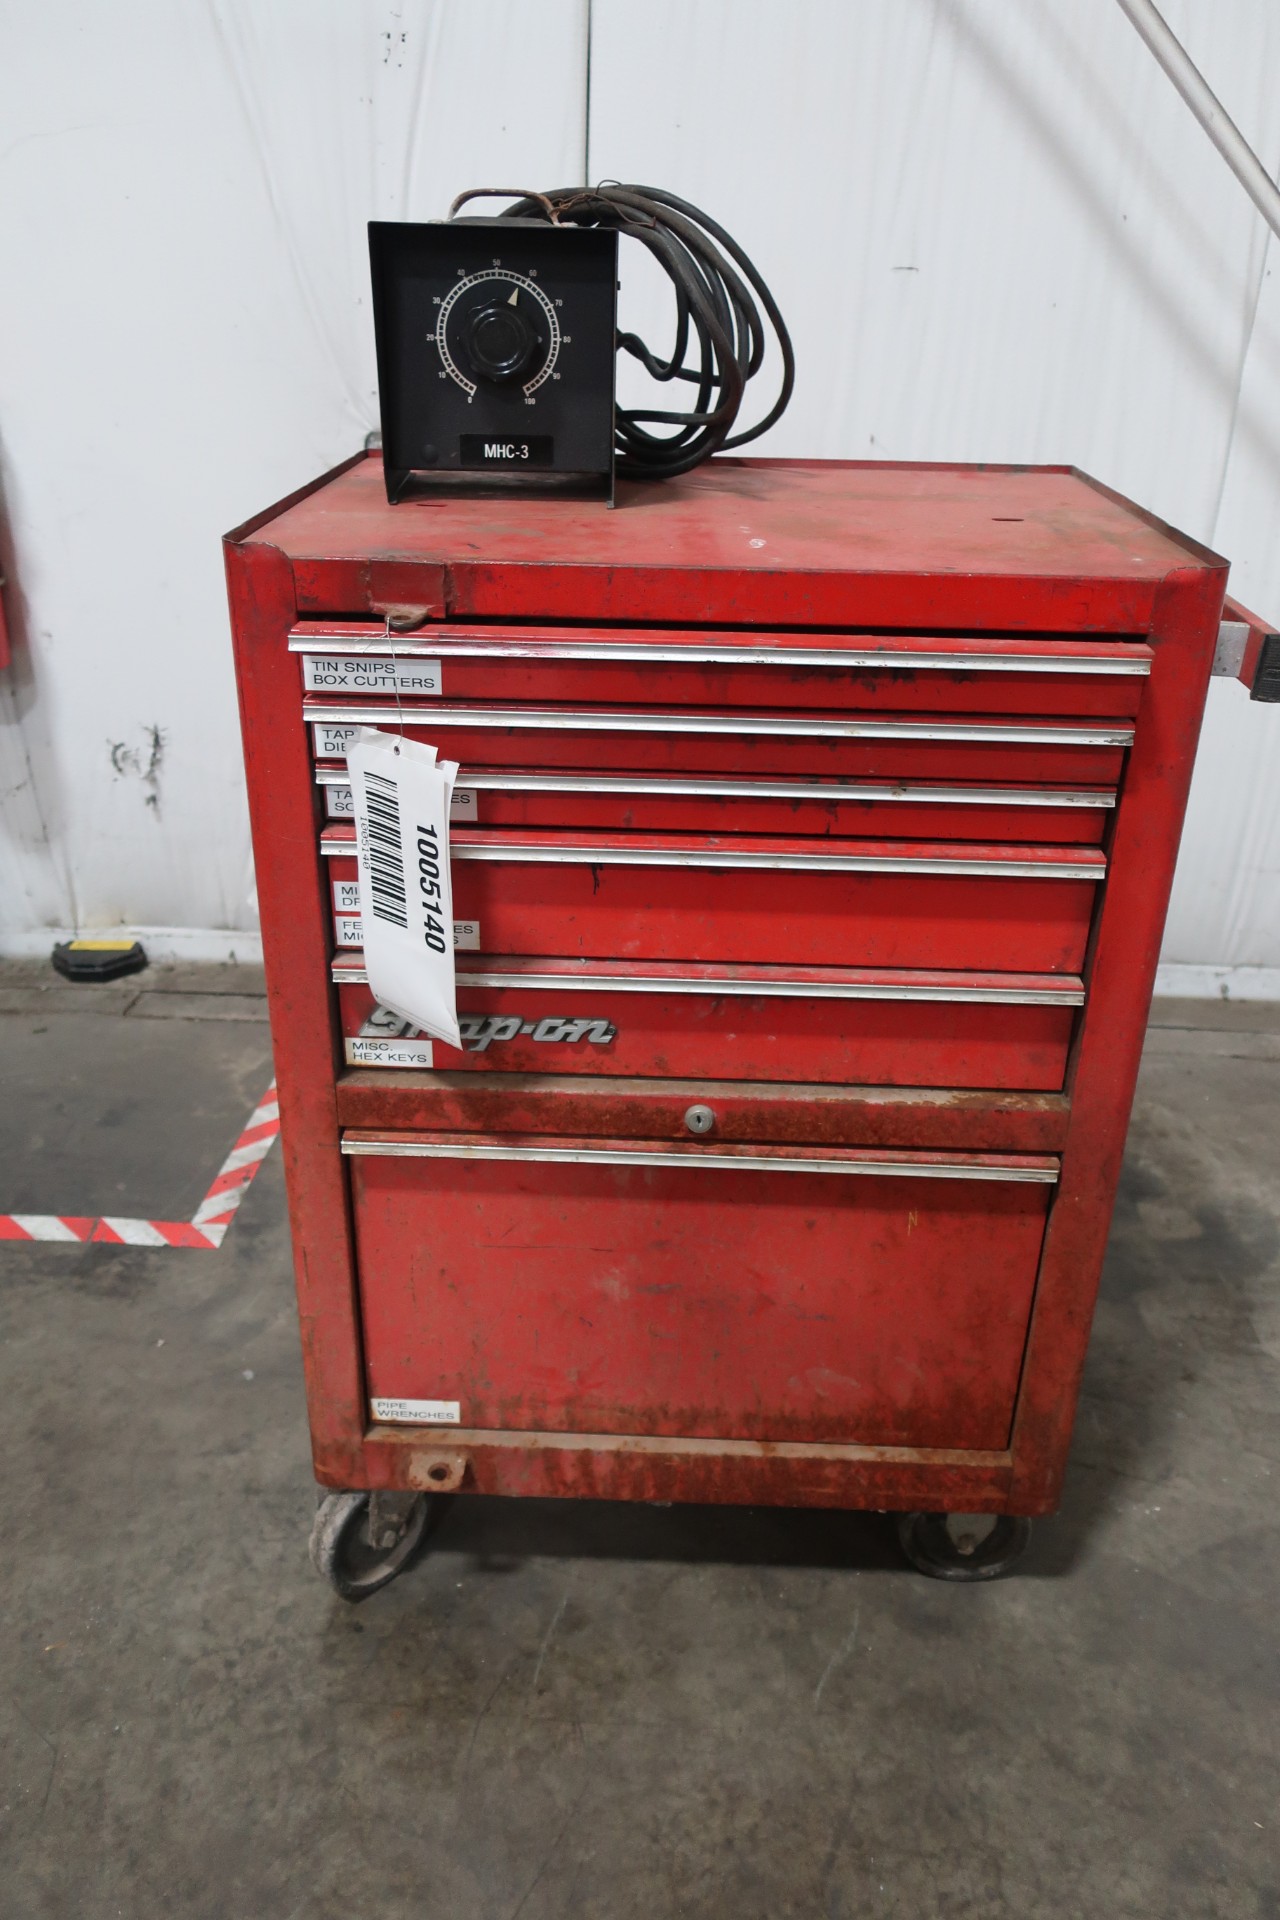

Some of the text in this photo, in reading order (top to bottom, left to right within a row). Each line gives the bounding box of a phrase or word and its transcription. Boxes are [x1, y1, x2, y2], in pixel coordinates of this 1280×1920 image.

[529, 269, 537, 277] 60
[467, 396, 472, 404] 0
[484, 443, 529, 459] MHC-3
[312, 661, 396, 674] TIN SNIPS
[313, 674, 435, 689] BOX CUTTERS
[360, 816, 370, 870] 1005140
[416, 824, 447, 954] 1005140
[352, 1042, 393, 1052] MISC.
[353, 1053, 427, 1063] HEX KEYS
[377, 1402, 407, 1410] PIPE
[377, 1410, 455, 1420] WRENCHES
